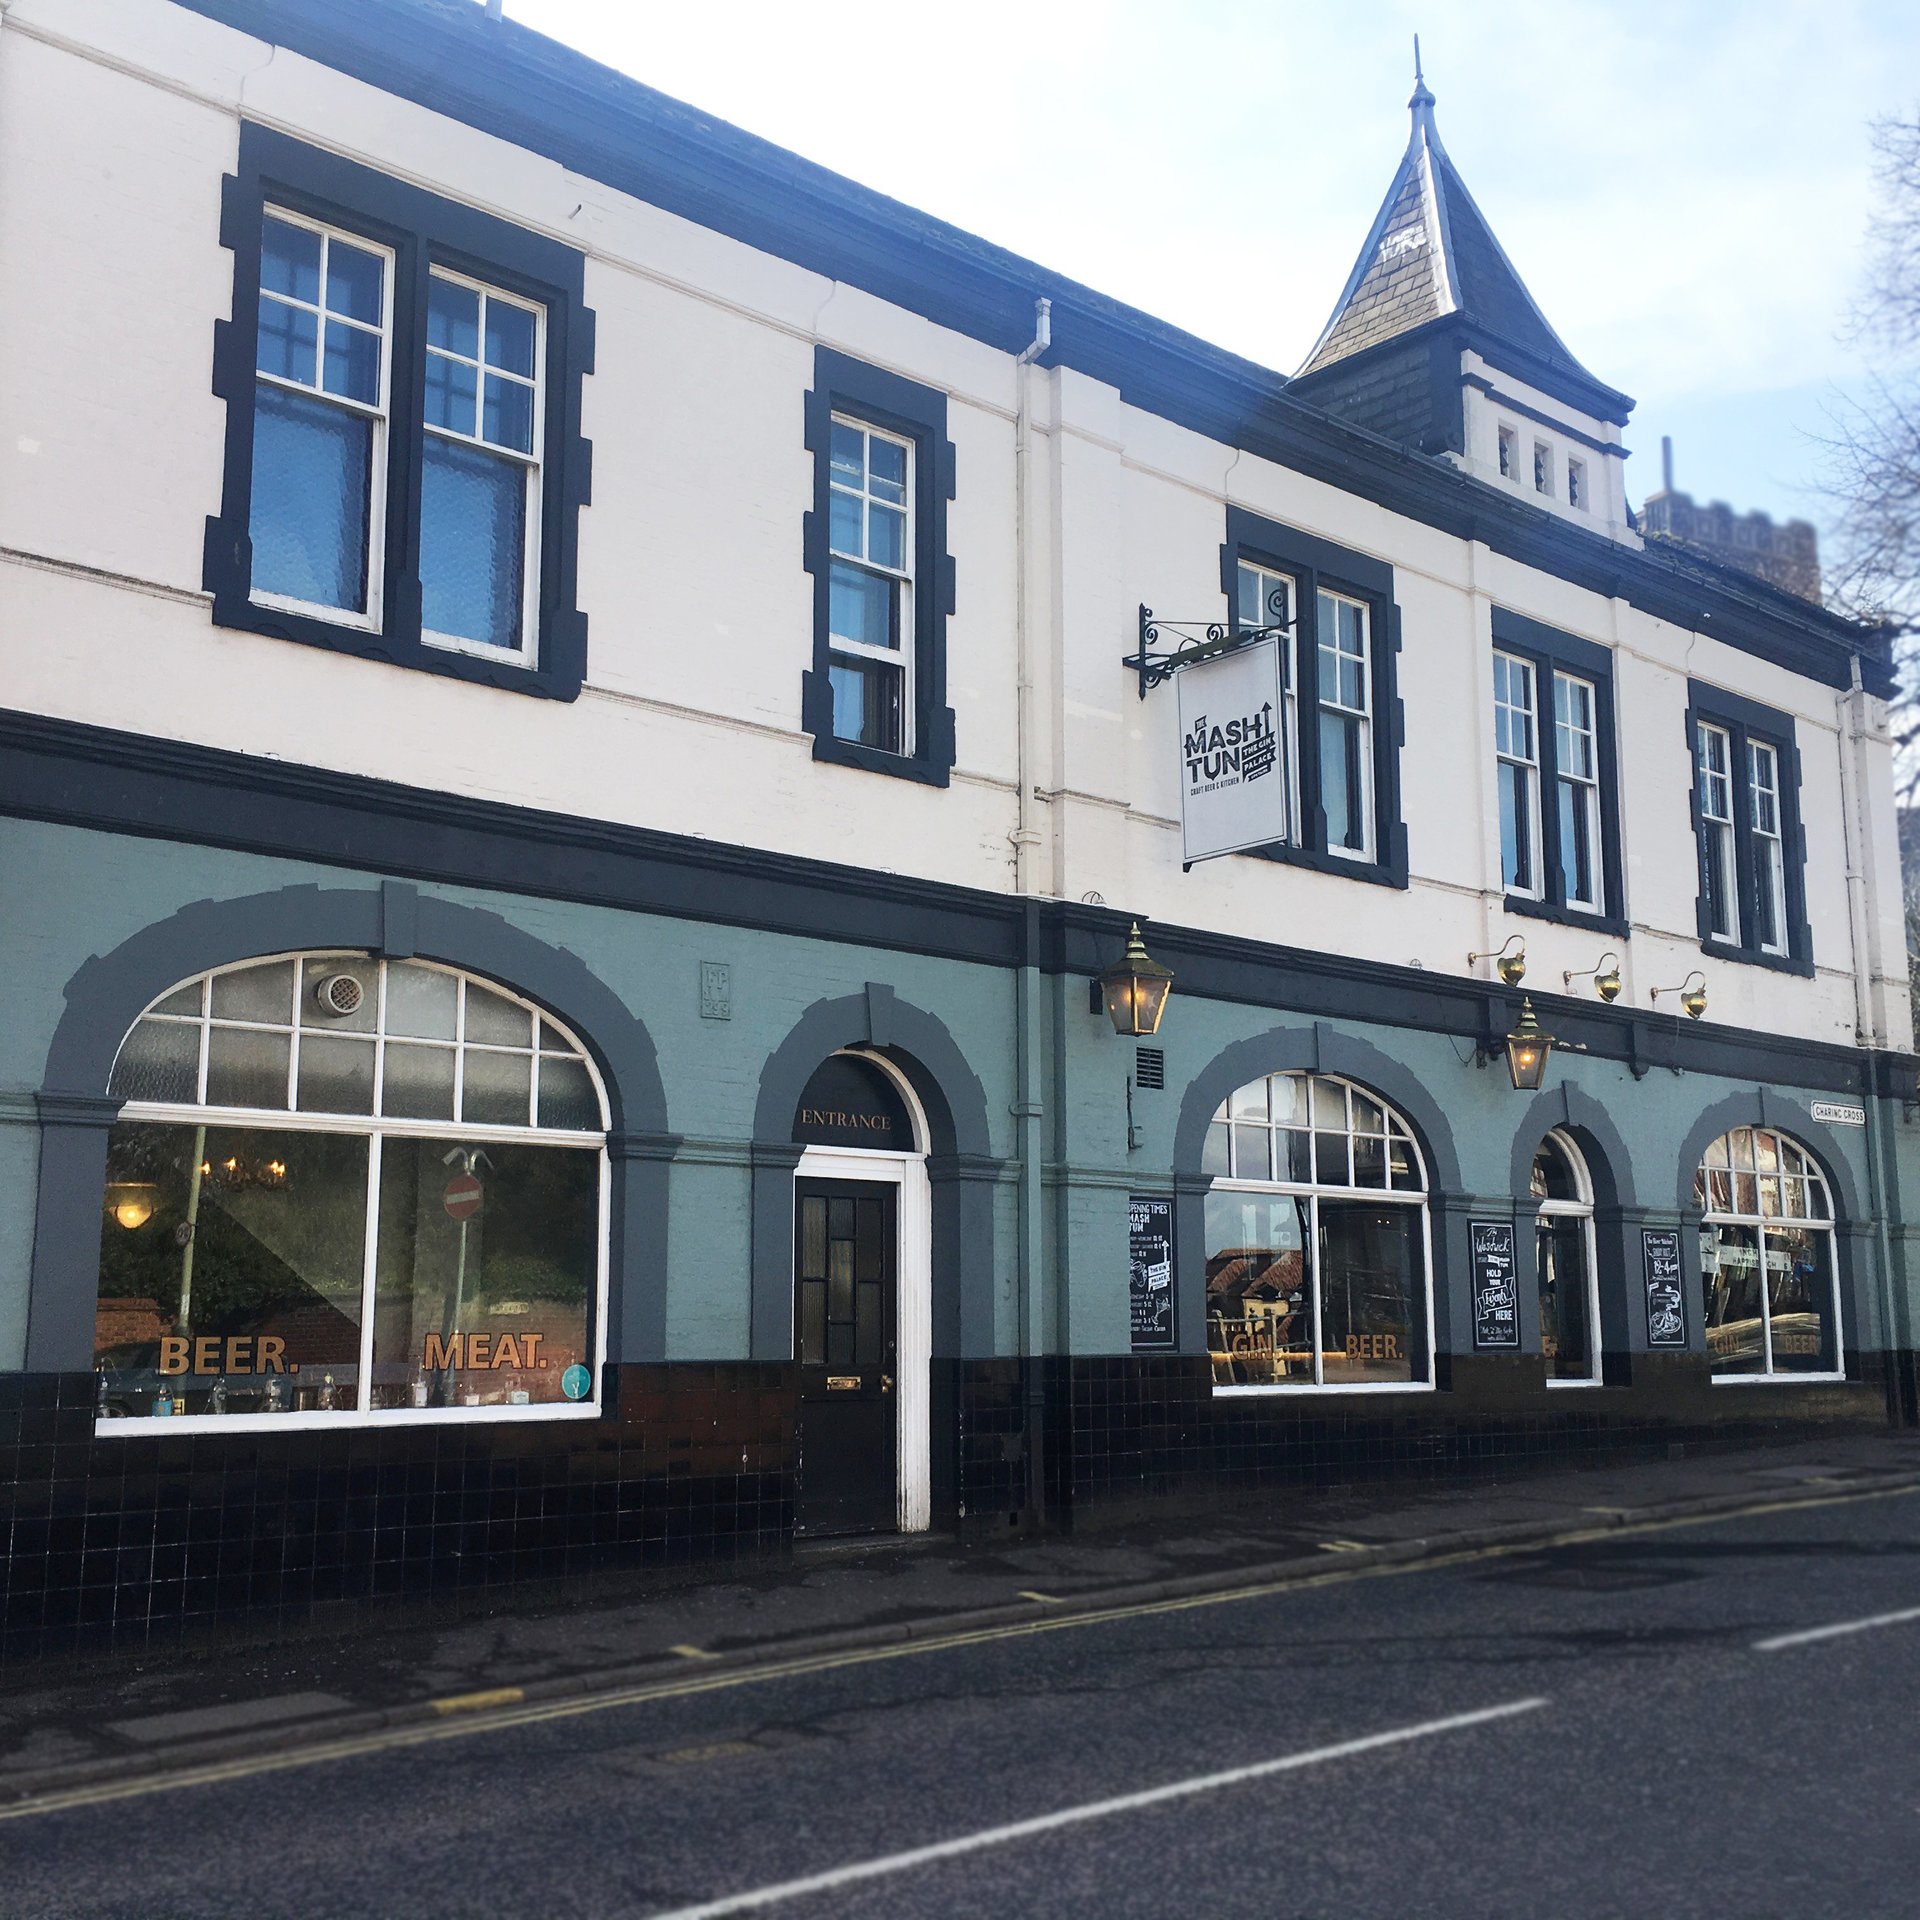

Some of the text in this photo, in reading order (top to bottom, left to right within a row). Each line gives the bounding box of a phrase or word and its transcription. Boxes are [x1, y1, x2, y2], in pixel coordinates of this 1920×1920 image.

[1184, 713, 1262, 758] MASH
[1243, 737, 1272, 756] THE GIN
[1186, 747, 1240, 783] TUN
[1244, 752, 1272, 772] PALACE
[1190, 785, 1204, 796] CRAFT
[1220, 777, 1239, 788] KITCHEN
[802, 1109, 891, 1130] ENTRANCE
[1843, 1109, 1864, 1121] CROSS
[1151, 1204, 1168, 1214] TIMES
[1486, 1269, 1502, 1277] HOLD
[1495, 1310, 1513, 1321] HERE
[159, 1336, 299, 1375] BEER.
[424, 1333, 548, 1370] MEAT.
[1345, 1334, 1403, 1359] BEER.
